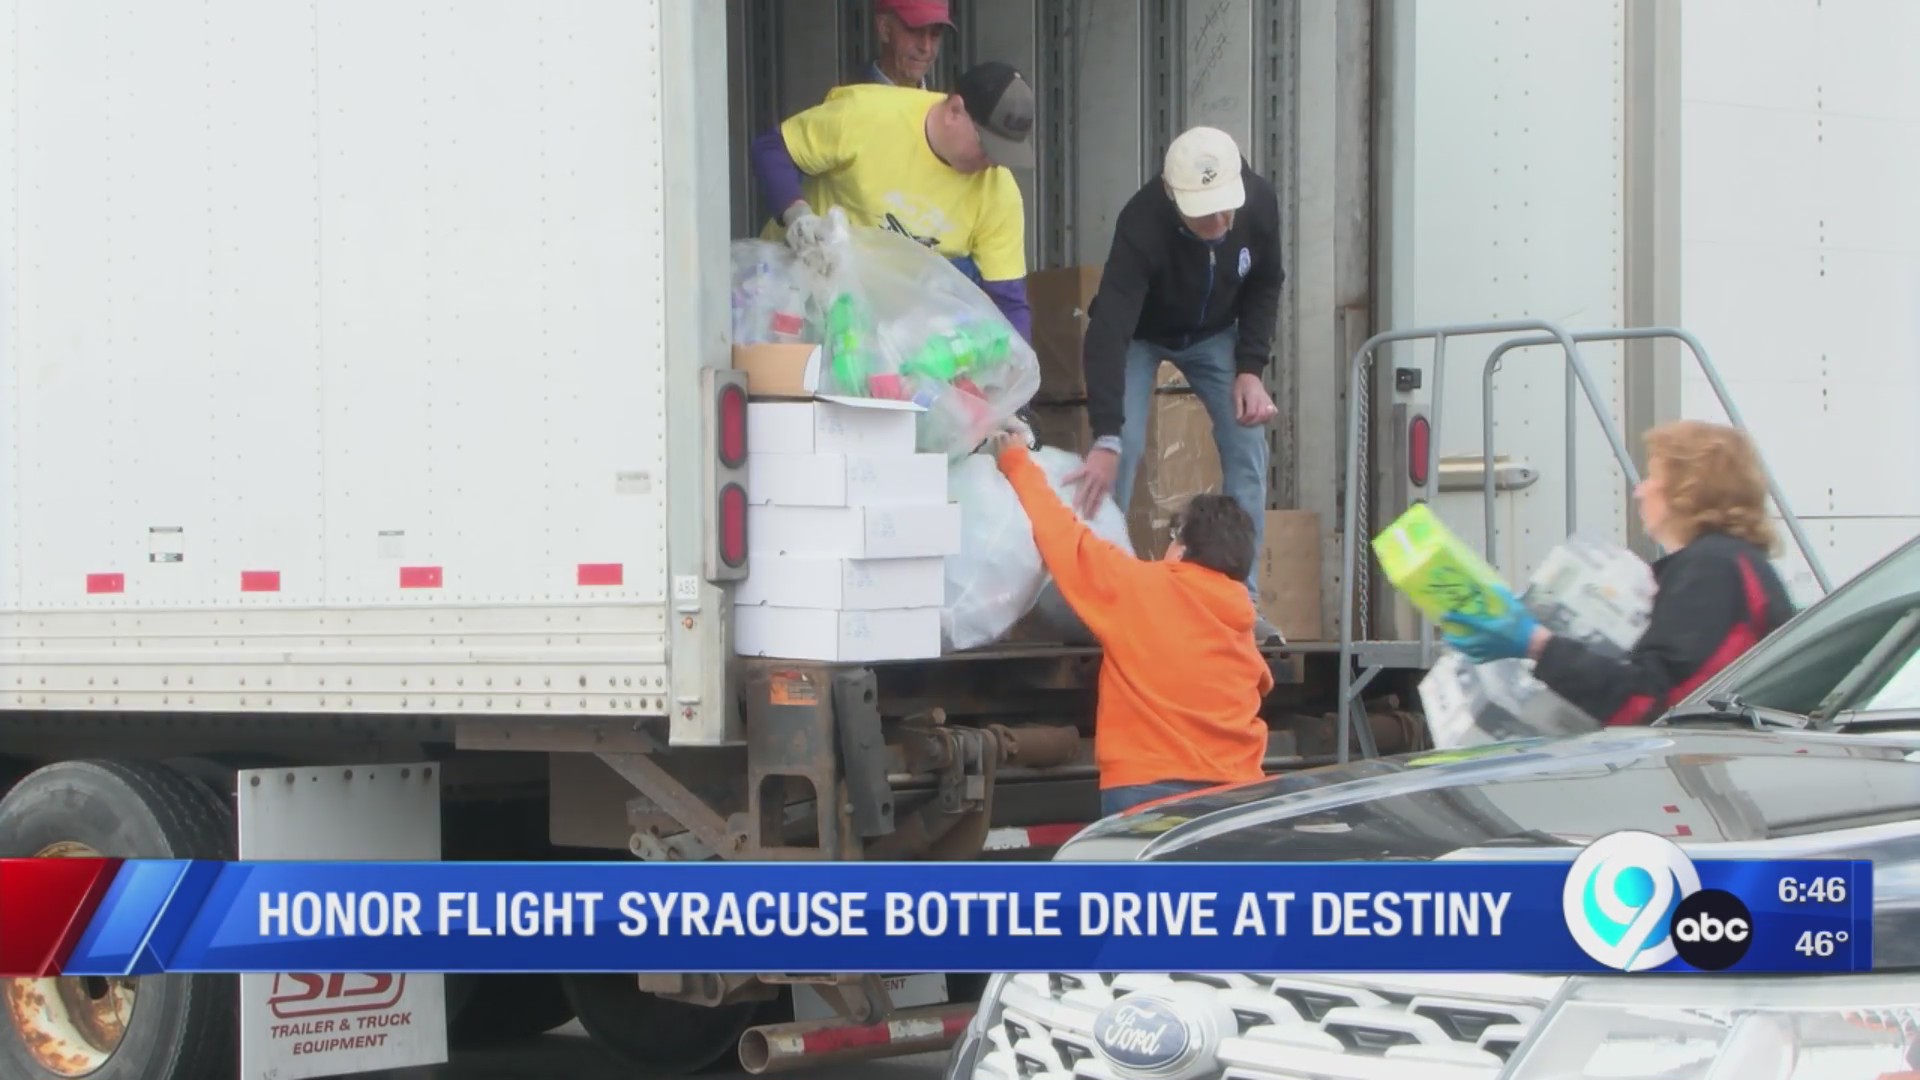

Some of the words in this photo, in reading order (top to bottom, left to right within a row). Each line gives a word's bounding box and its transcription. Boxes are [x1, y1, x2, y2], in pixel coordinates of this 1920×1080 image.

[677, 579, 697, 595] ABS
[270, 1020, 334, 1038] TRAILER
[339, 1018, 351, 1032] &
[356, 1012, 412, 1029] TRUCK
[1104, 1005, 1168, 1056] Ford
[292, 1034, 387, 1055] EQUIPMENT
